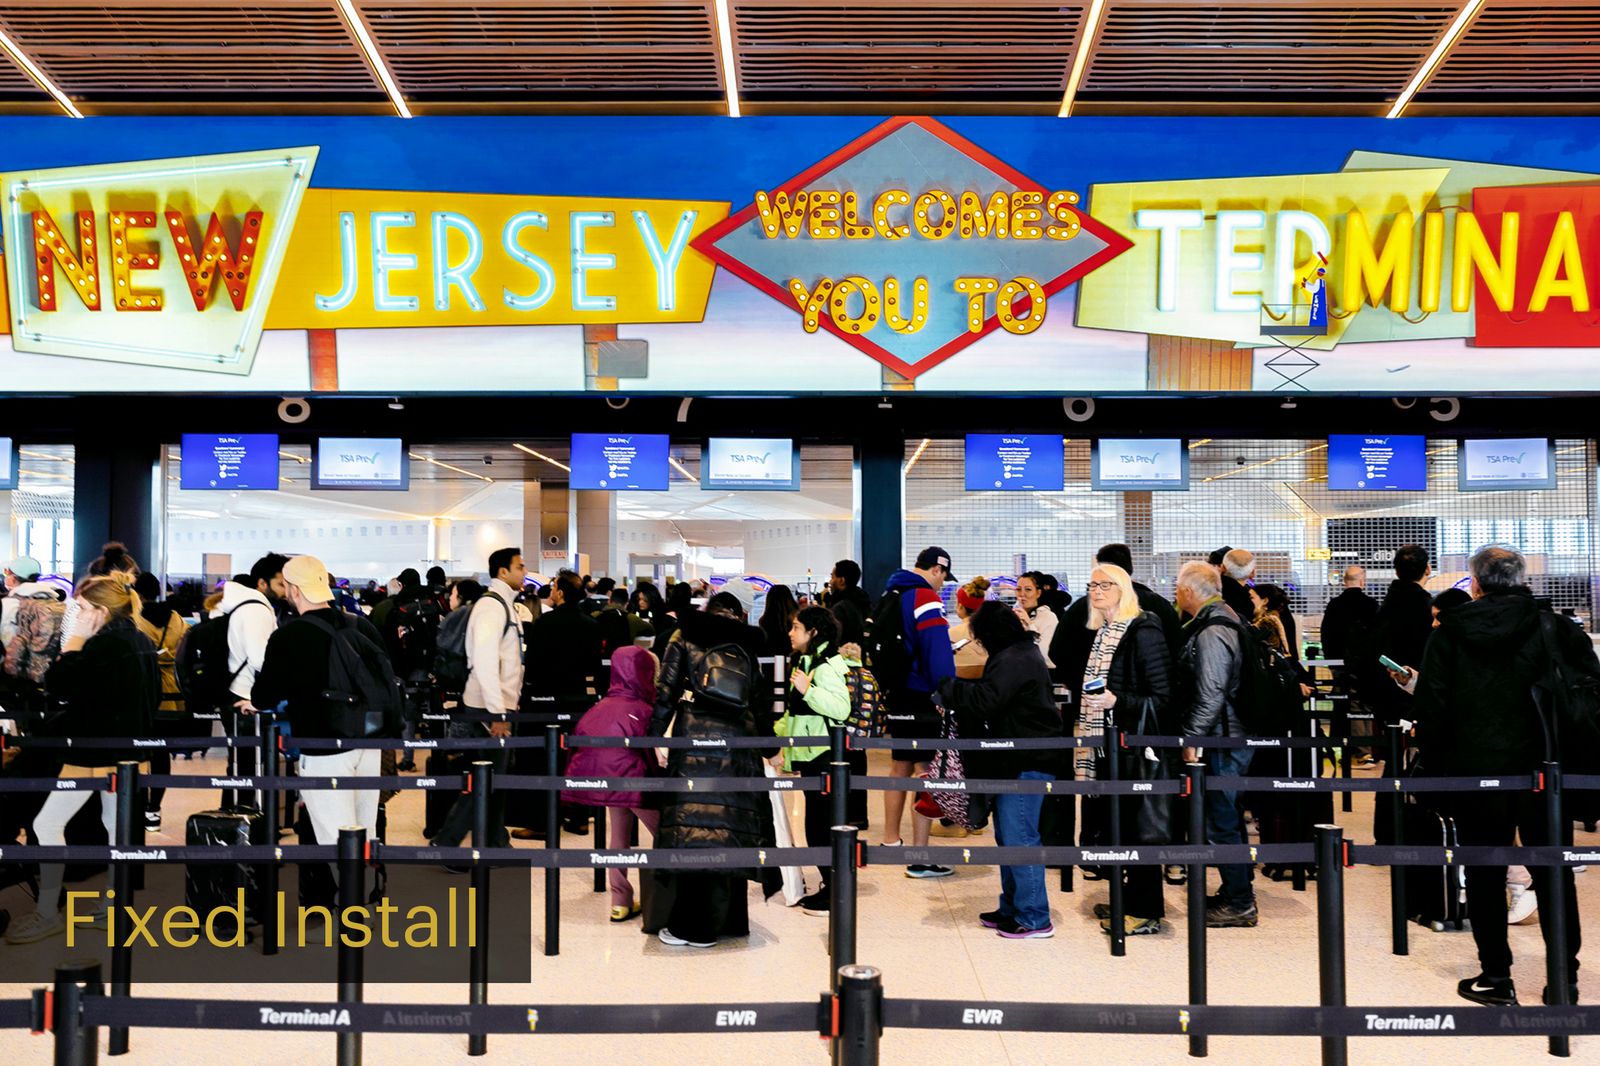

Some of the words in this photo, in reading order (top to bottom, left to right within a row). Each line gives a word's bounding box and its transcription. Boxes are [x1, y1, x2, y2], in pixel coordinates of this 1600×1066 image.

[754, 190, 1081, 241] WELCOMES
[32, 210, 264, 311] NEW
[315, 211, 699, 311] JERSEY
[788, 277, 928, 334] YOU
[953, 277, 1047, 334] TO
[340, 454, 354, 464] TSA
[356, 454, 370, 464] Pre
[731, 454, 744, 463] TSA
[746, 454, 760, 463] Pre
[1120, 455, 1134, 463] TSA
[1136, 455, 1150, 463] Pre
[1486, 455, 1501, 463] TSA
[1503, 455, 1516, 463] Pre
[132, 739, 160, 747] Terminal
[161, 739, 166, 747] A
[692, 739, 720, 747] Terminal
[721, 739, 726, 747] A
[210, 777, 246, 787] Terminal
[247, 777, 253, 787] A
[416, 778, 436, 787] EWR
[564, 779, 601, 789] Terminal
[602, 779, 608, 789] A
[773, 780, 793, 788] EWR
[923, 780, 959, 790] Terminal
[960, 780, 966, 790] A
[1132, 782, 1153, 791] EWR
[1272, 780, 1308, 789] Terminal
[1309, 780, 1315, 789] A
[1480, 780, 1500, 788] EWR
[110, 849, 157, 861] Terminal
[158, 849, 168, 861] A
[589, 852, 638, 864] Terminal
[639, 852, 649, 864] A
[1080, 850, 1129, 861] Terminal
[1130, 850, 1140, 861] A
[259, 1007, 336, 1026] Terminal
[337, 1007, 352, 1026] A
[716, 1010, 757, 1026] EWR
[962, 1009, 1003, 1025] EWR
[1364, 1014, 1441, 1030] Terminal
[1442, 1014, 1456, 1030] A
